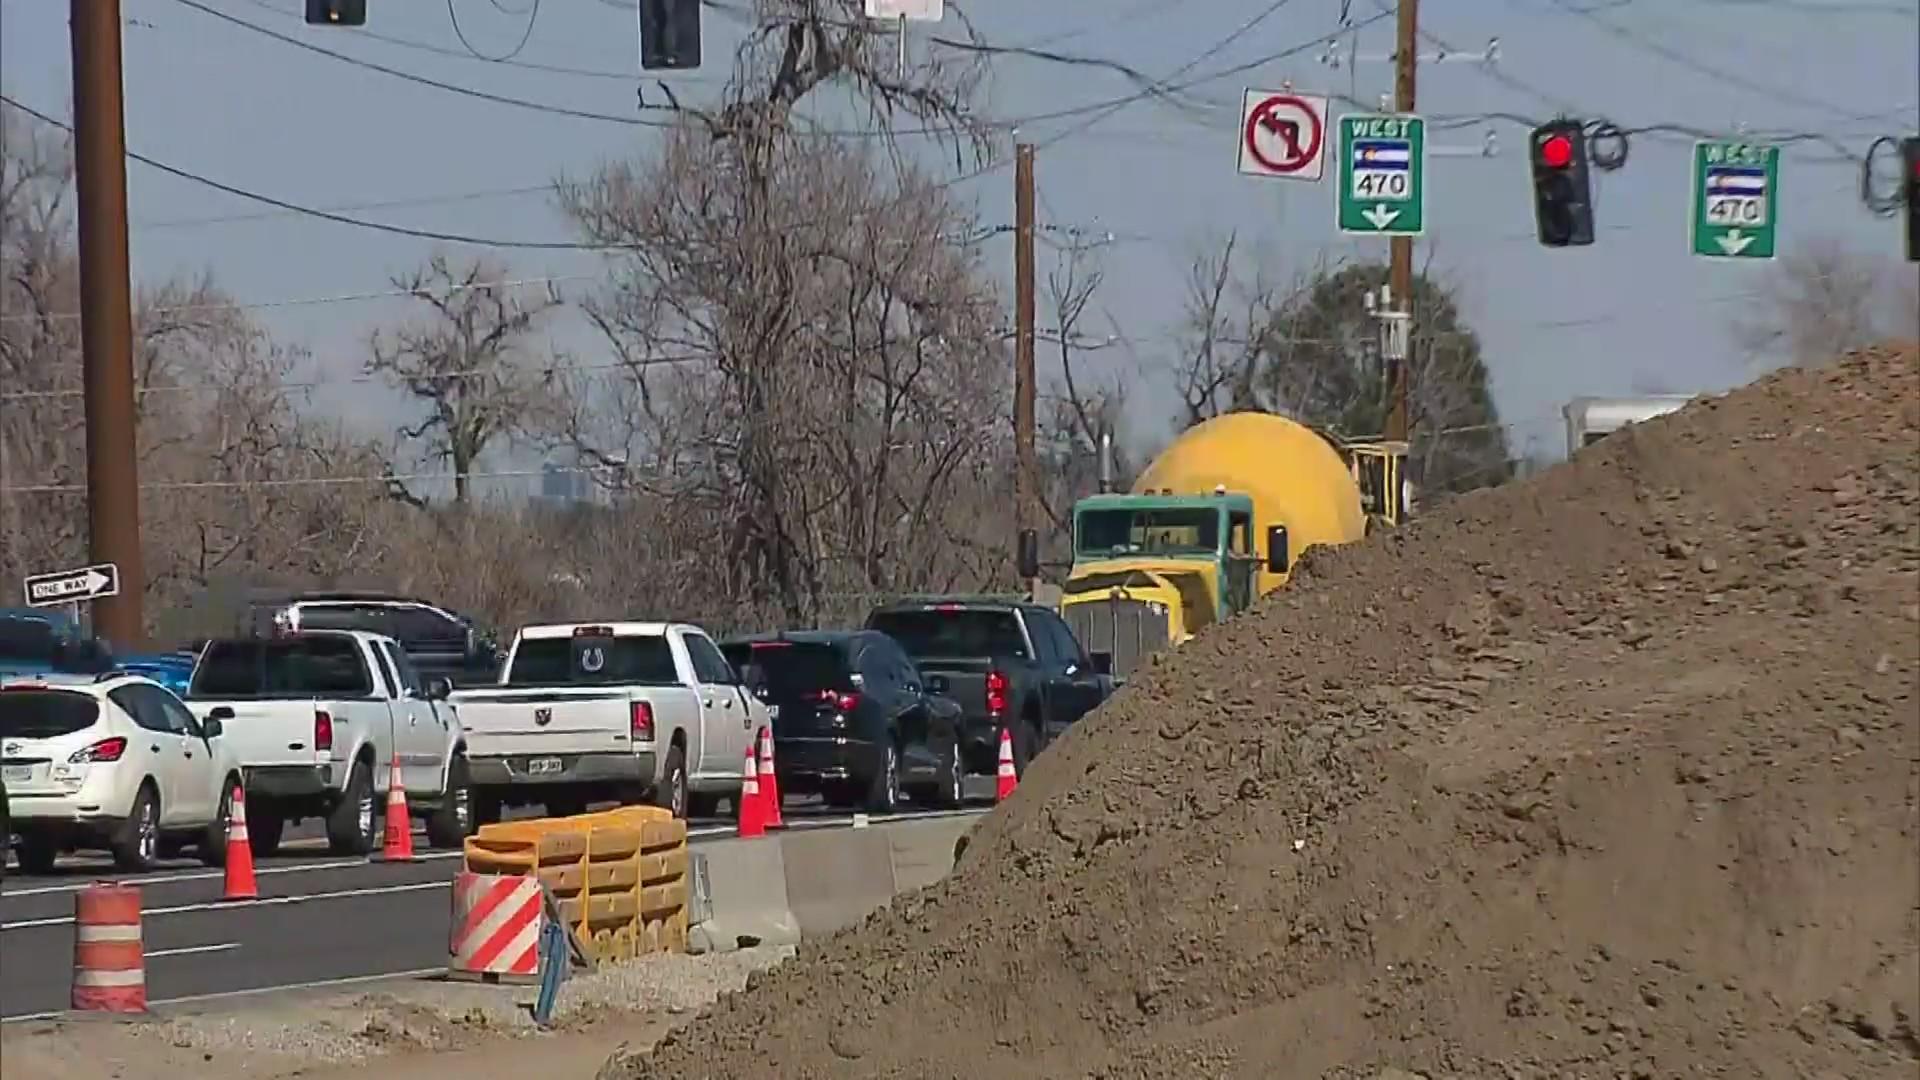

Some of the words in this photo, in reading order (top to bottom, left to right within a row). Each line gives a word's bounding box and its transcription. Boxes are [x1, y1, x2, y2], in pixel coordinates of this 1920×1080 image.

[1352, 119, 1409, 137] WEST
[1357, 174, 1405, 195] 470
[1710, 199, 1759, 221] 470
[36, 583, 59, 595] ONE
[64, 578, 88, 591] WAY
